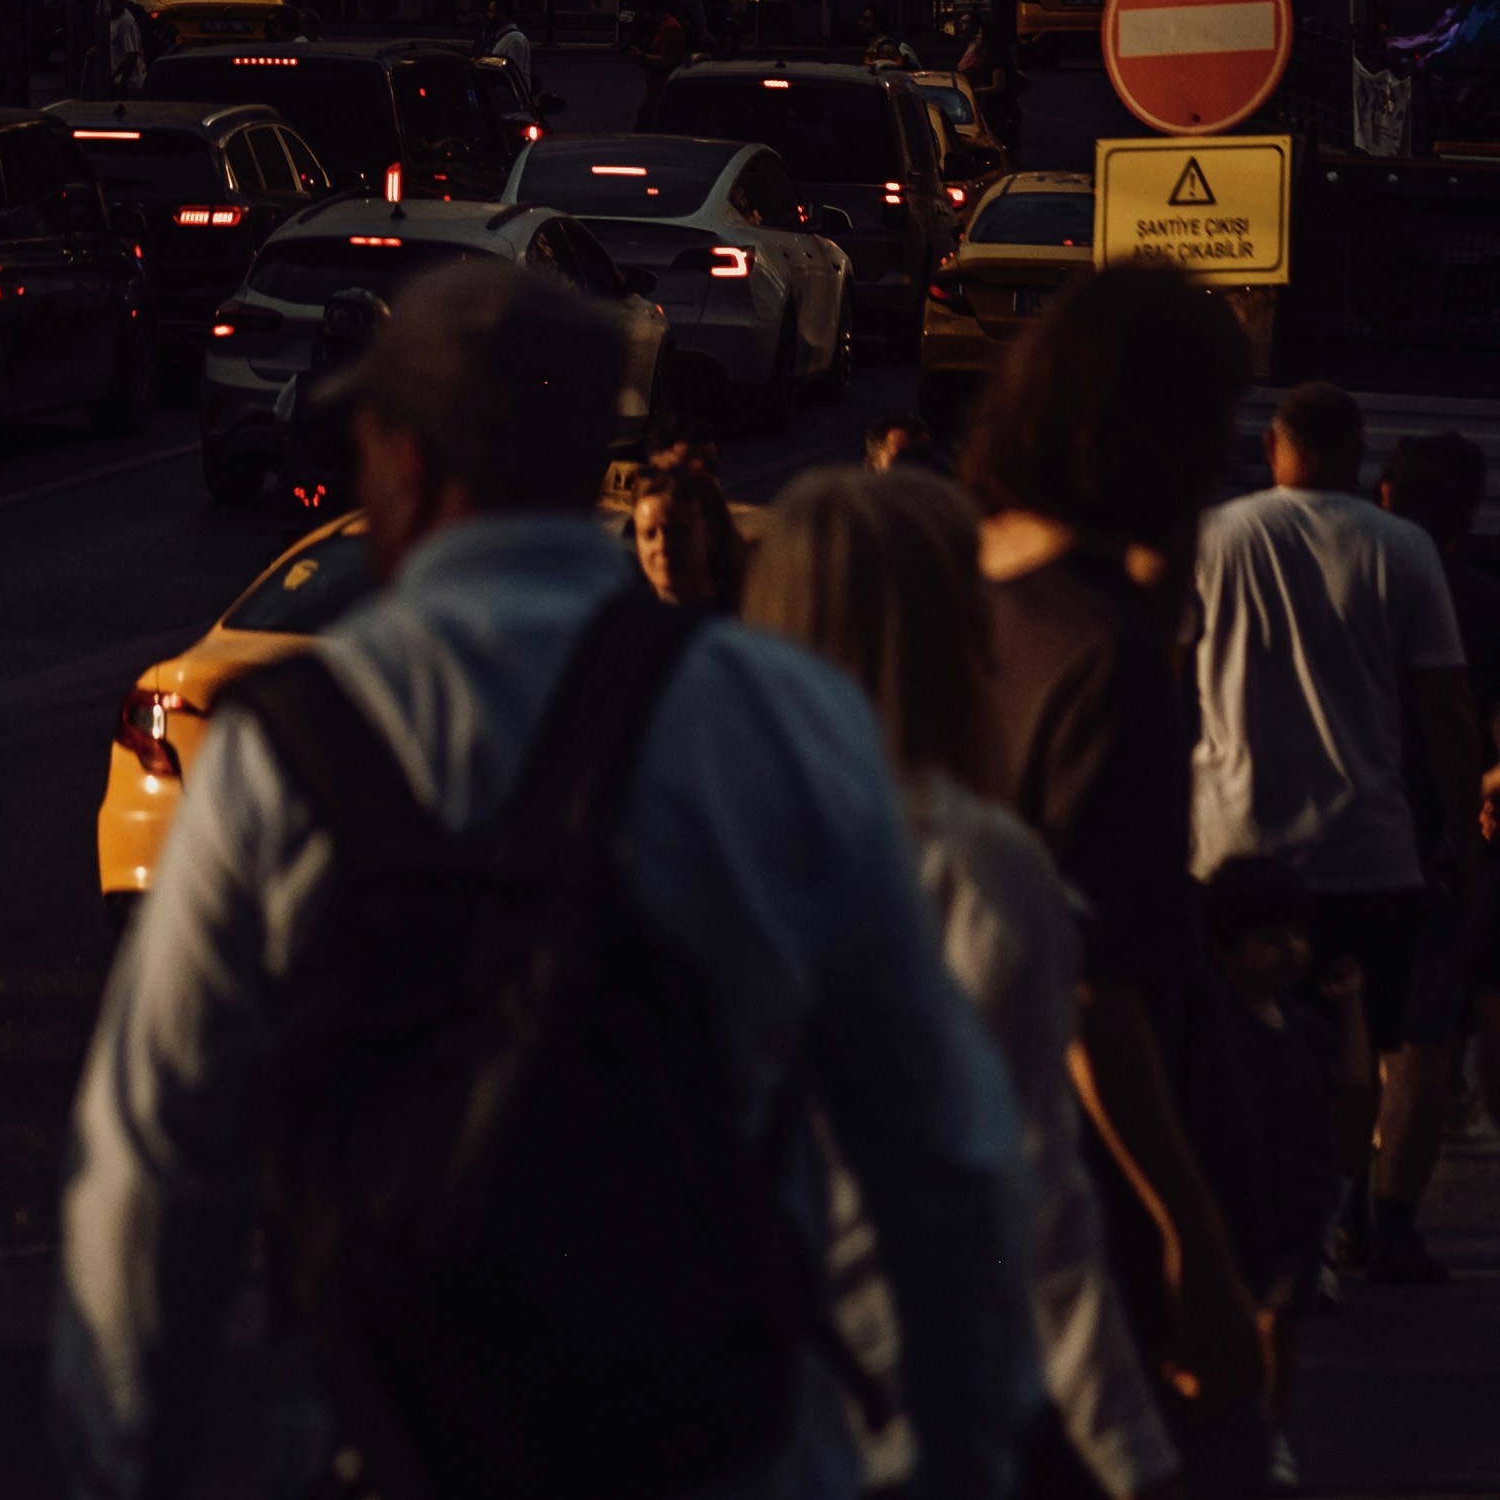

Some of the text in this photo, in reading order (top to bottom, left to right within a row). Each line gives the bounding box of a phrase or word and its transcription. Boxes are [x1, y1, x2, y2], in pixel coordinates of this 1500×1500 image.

[1136, 215, 1250, 240] ŞANTİYE ÇIKIŞI
[1177, 237, 1255, 264] ÇIKABİLİR
